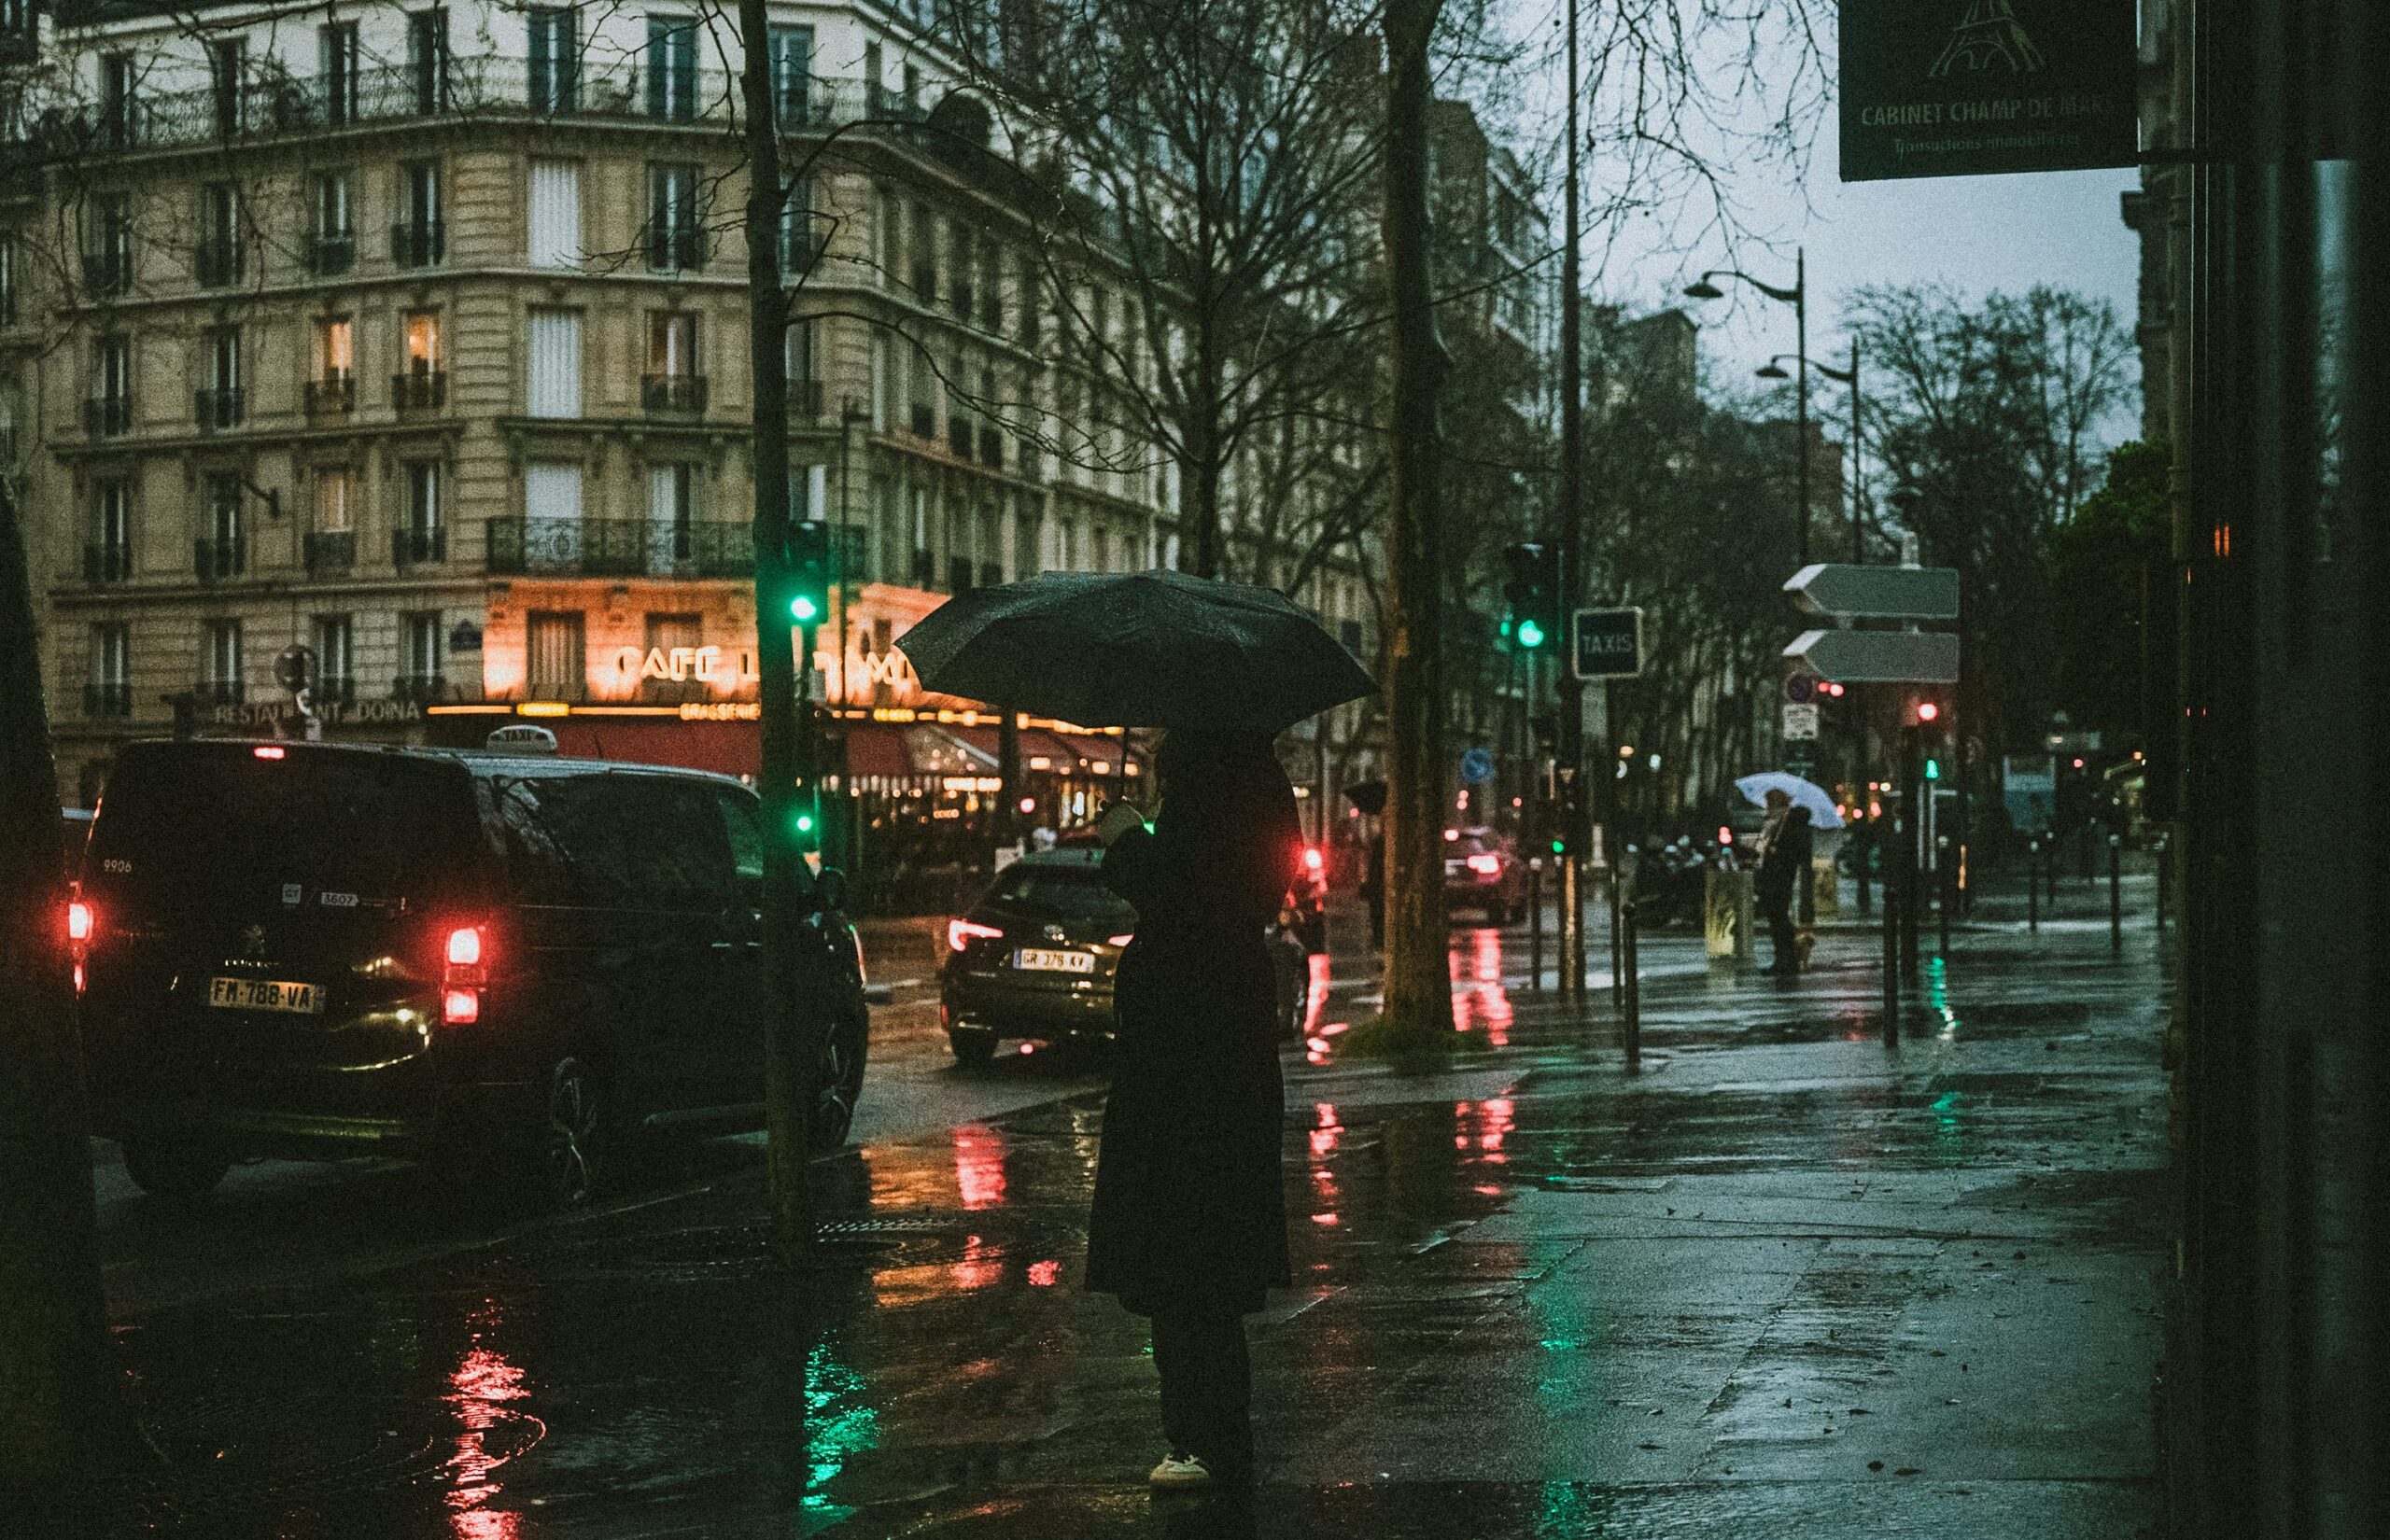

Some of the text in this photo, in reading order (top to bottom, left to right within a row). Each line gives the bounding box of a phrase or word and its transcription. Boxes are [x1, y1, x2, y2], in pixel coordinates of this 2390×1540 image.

[1861, 102, 1944, 127] CABINET
[1949, 97, 2022, 123] CHAMP
[2027, 96, 2053, 119] DE
[1581, 632, 1634, 655] TAXIS
[215, 701, 343, 726] RESTAUNT
[505, 729, 531, 742] TAXI
[104, 859, 133, 874] 9906
